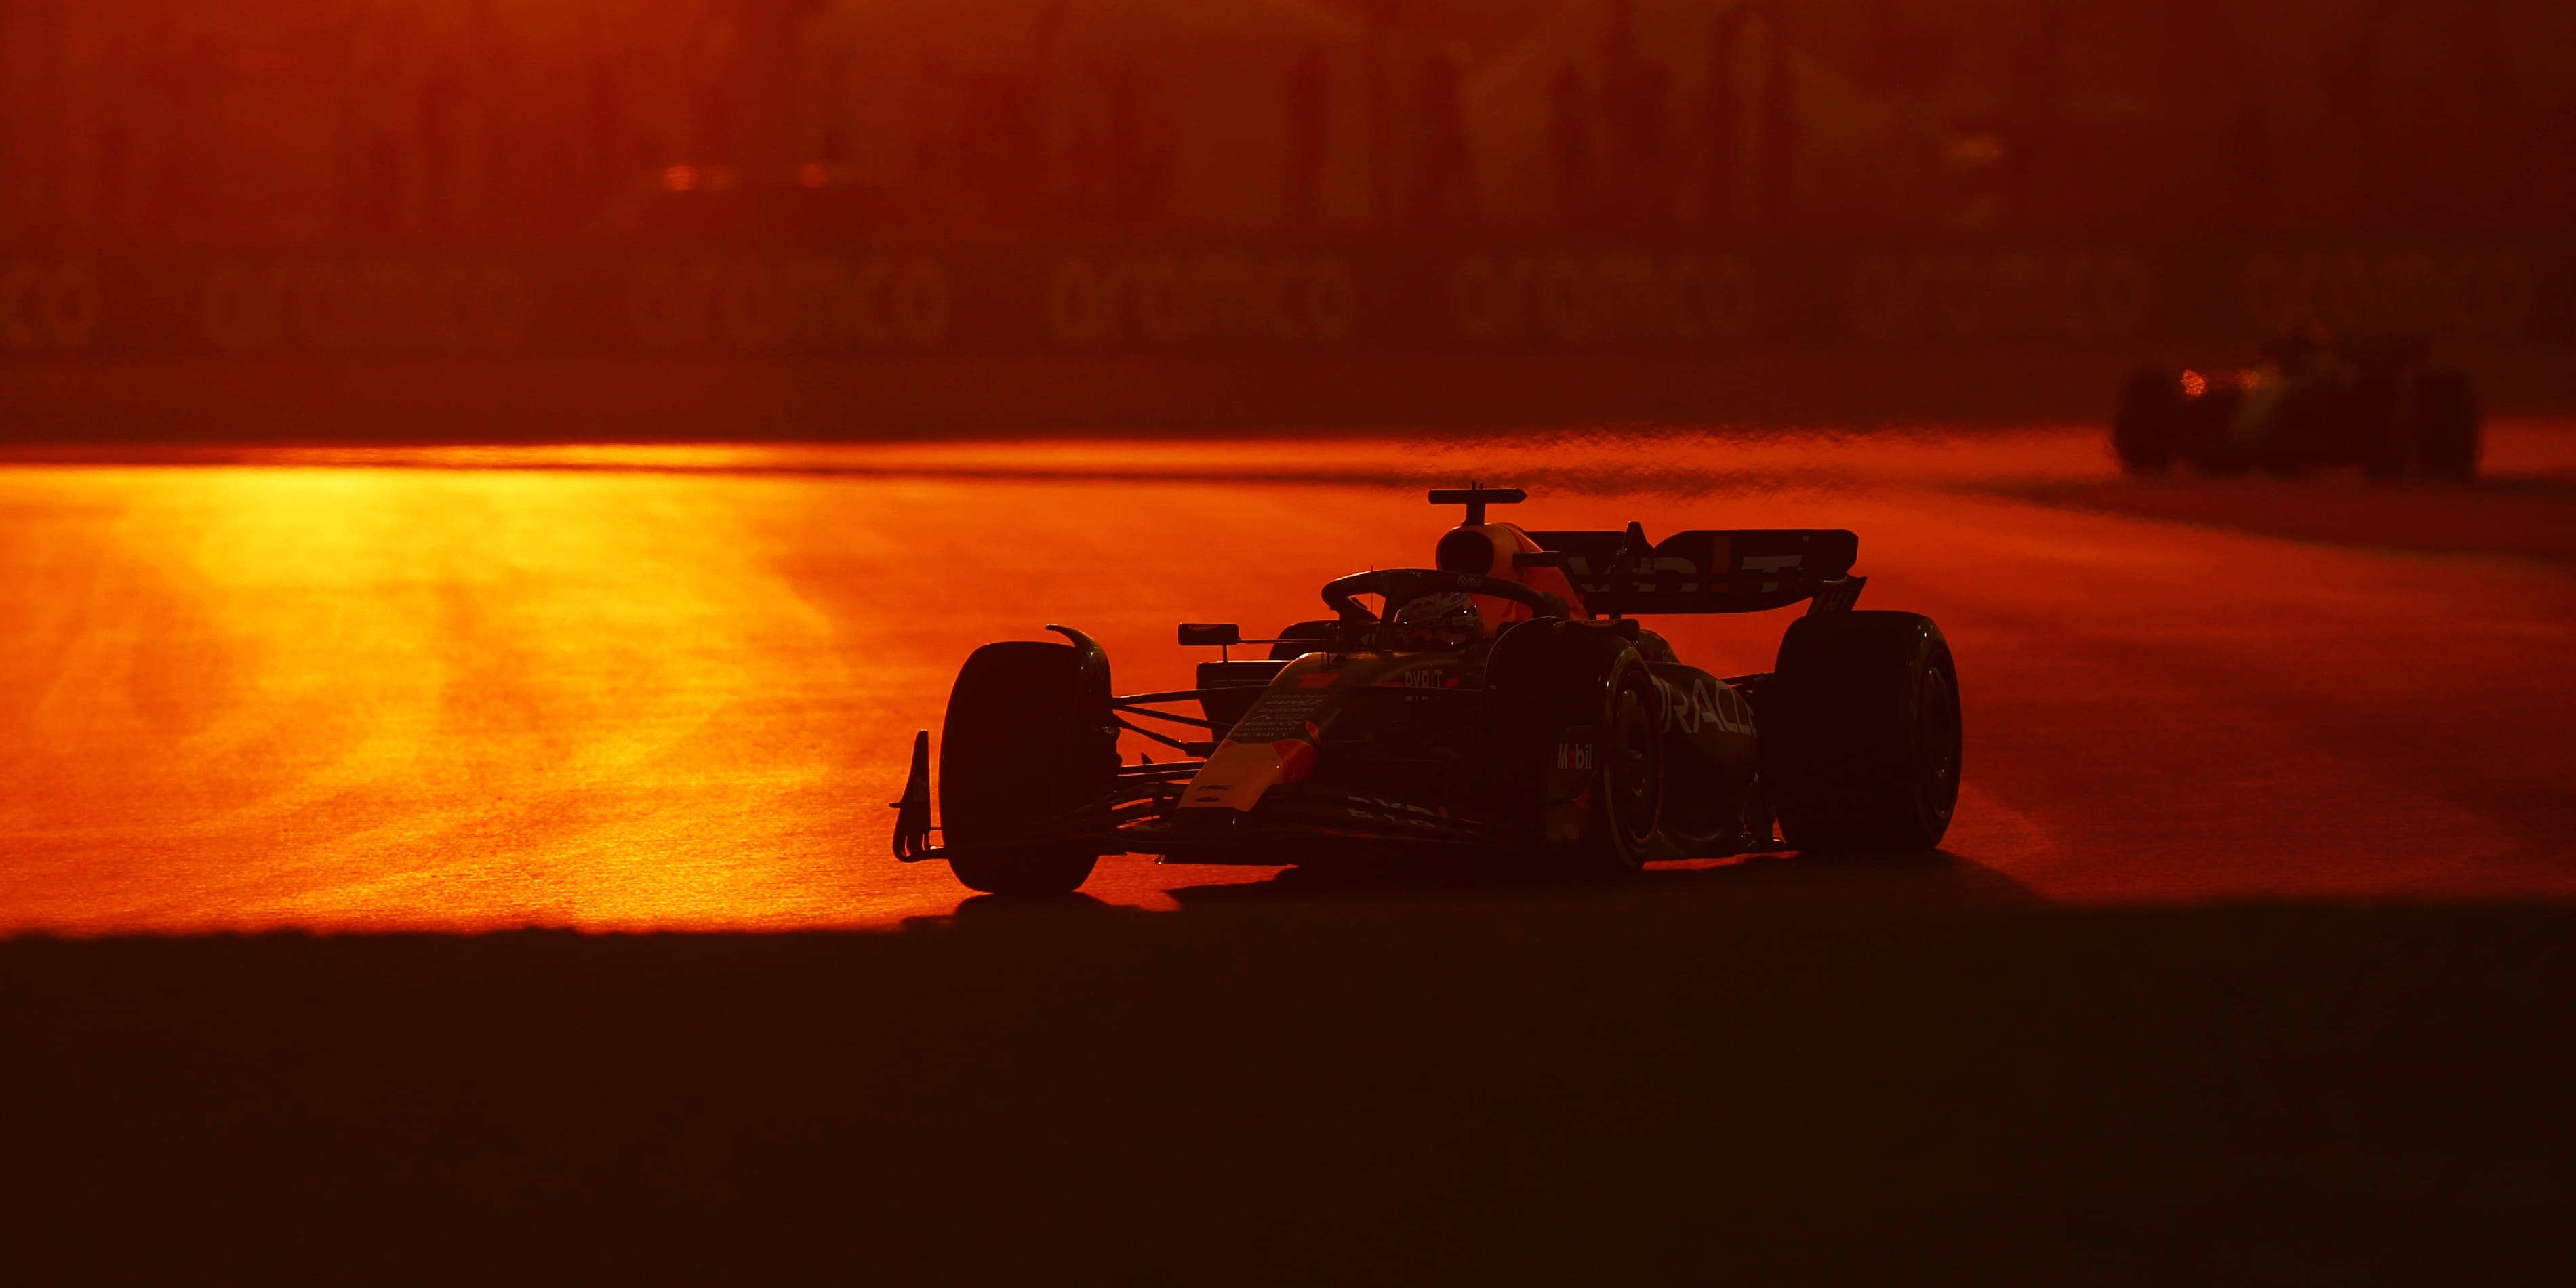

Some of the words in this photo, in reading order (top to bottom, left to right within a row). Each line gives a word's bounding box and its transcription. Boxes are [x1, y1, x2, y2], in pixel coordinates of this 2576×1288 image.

[202, 259, 530, 350] aramco
[624, 254, 954, 347] aramco
[1044, 254, 1352, 345] aramco
[1451, 253, 1756, 344] aramco
[1848, 252, 2149, 338] aramco
[1557, 742, 1593, 770] Mobil
